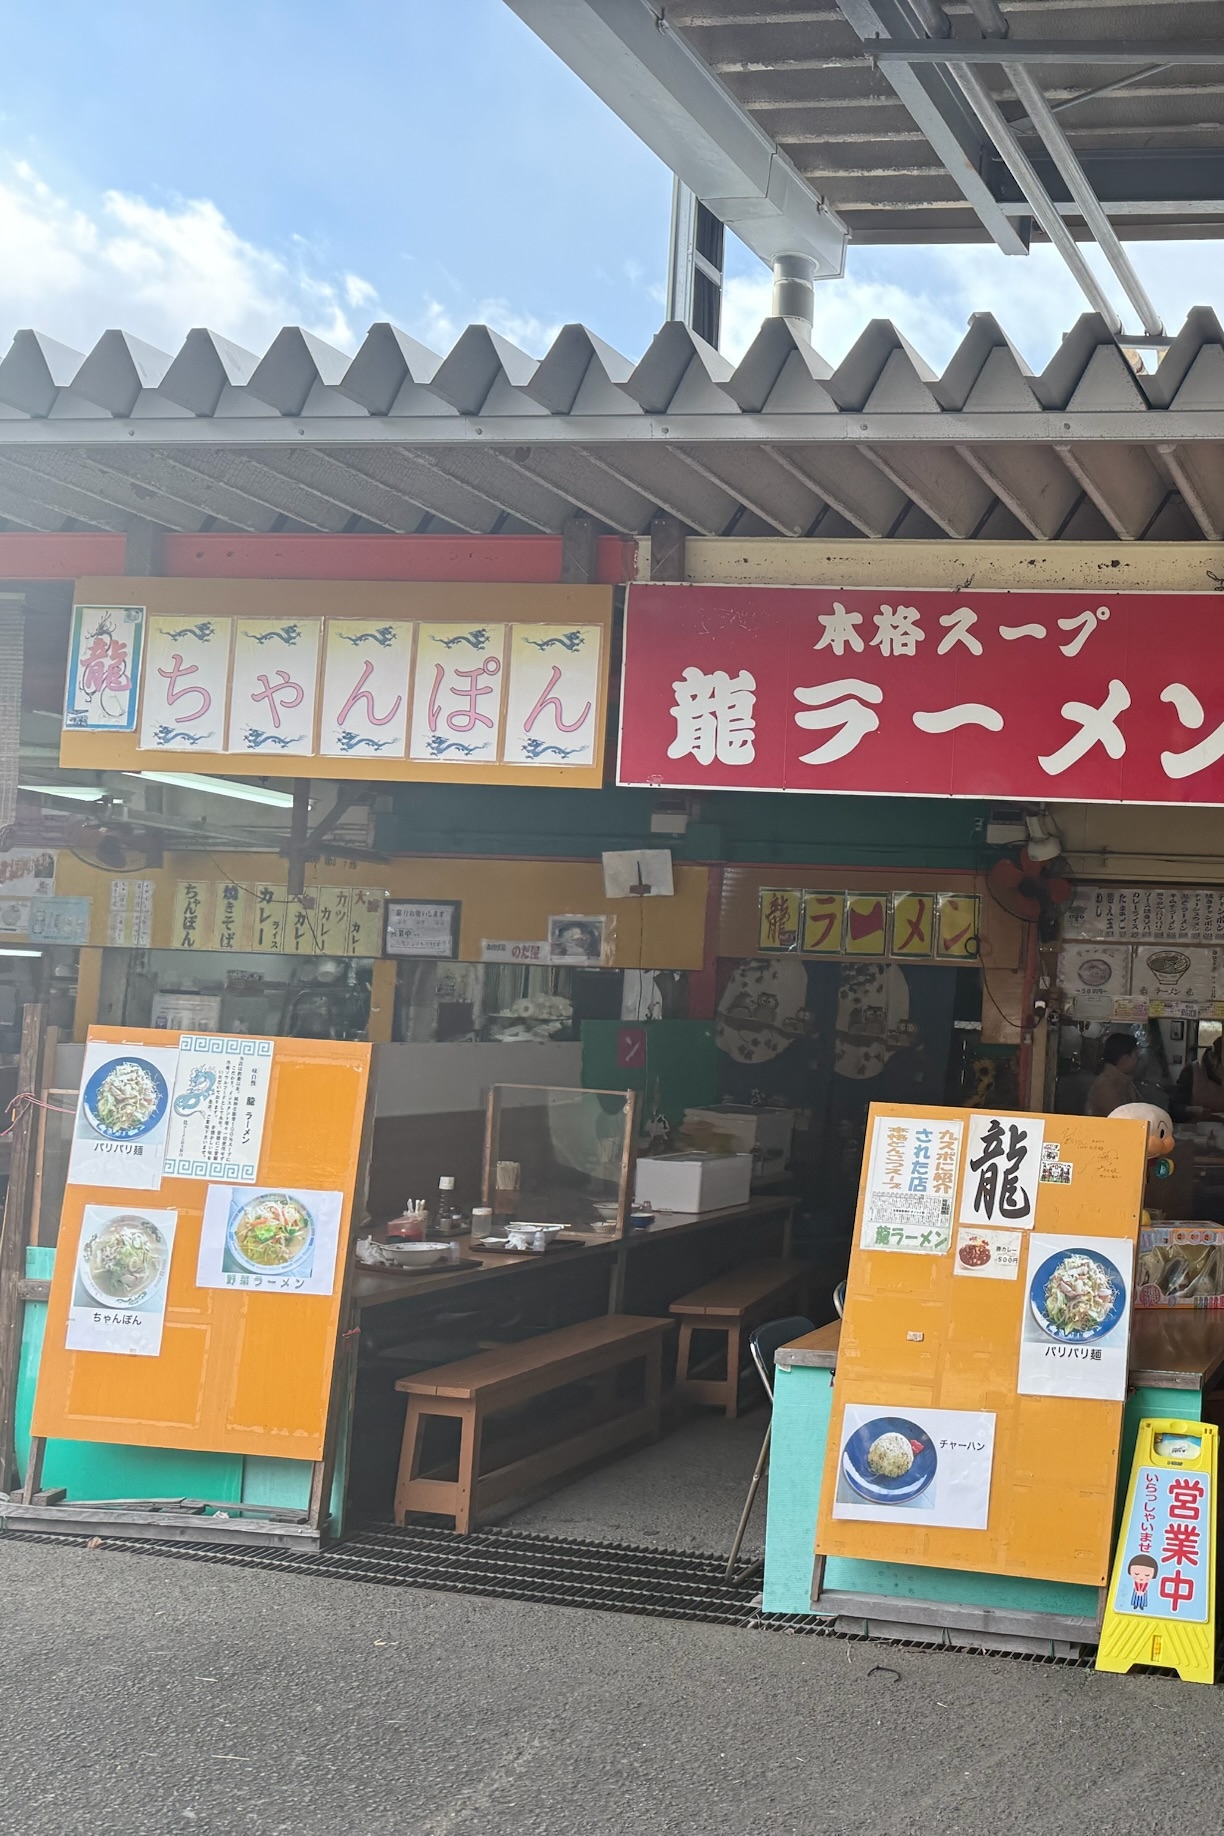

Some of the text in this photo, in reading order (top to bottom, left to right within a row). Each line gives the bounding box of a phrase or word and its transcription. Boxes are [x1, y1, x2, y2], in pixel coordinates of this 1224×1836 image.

[813, 602, 1110, 658] 本格スープ
[157, 653, 592, 732] ちゃんぽん
[181, 883, 200, 947] ちゃんぽん
[219, 884, 239, 948] 焼きそば
[242, 1111, 254, 1145] ラーメン
[908, 1128, 933, 1192] された店
[932, 1129, 958, 1195] 九スポに紹介
[969, 1118, 1031, 1221] 龍
[226, 1273, 305, 1290] 野菜ラーメン
[92, 1311, 142, 1326] ちゃんぽん
[939, 1439, 985, 1451] チャーハン
[1138, 1472, 1160, 1554] いらっしゃいませ
[1159, 1477, 1205, 1612] 営業中
